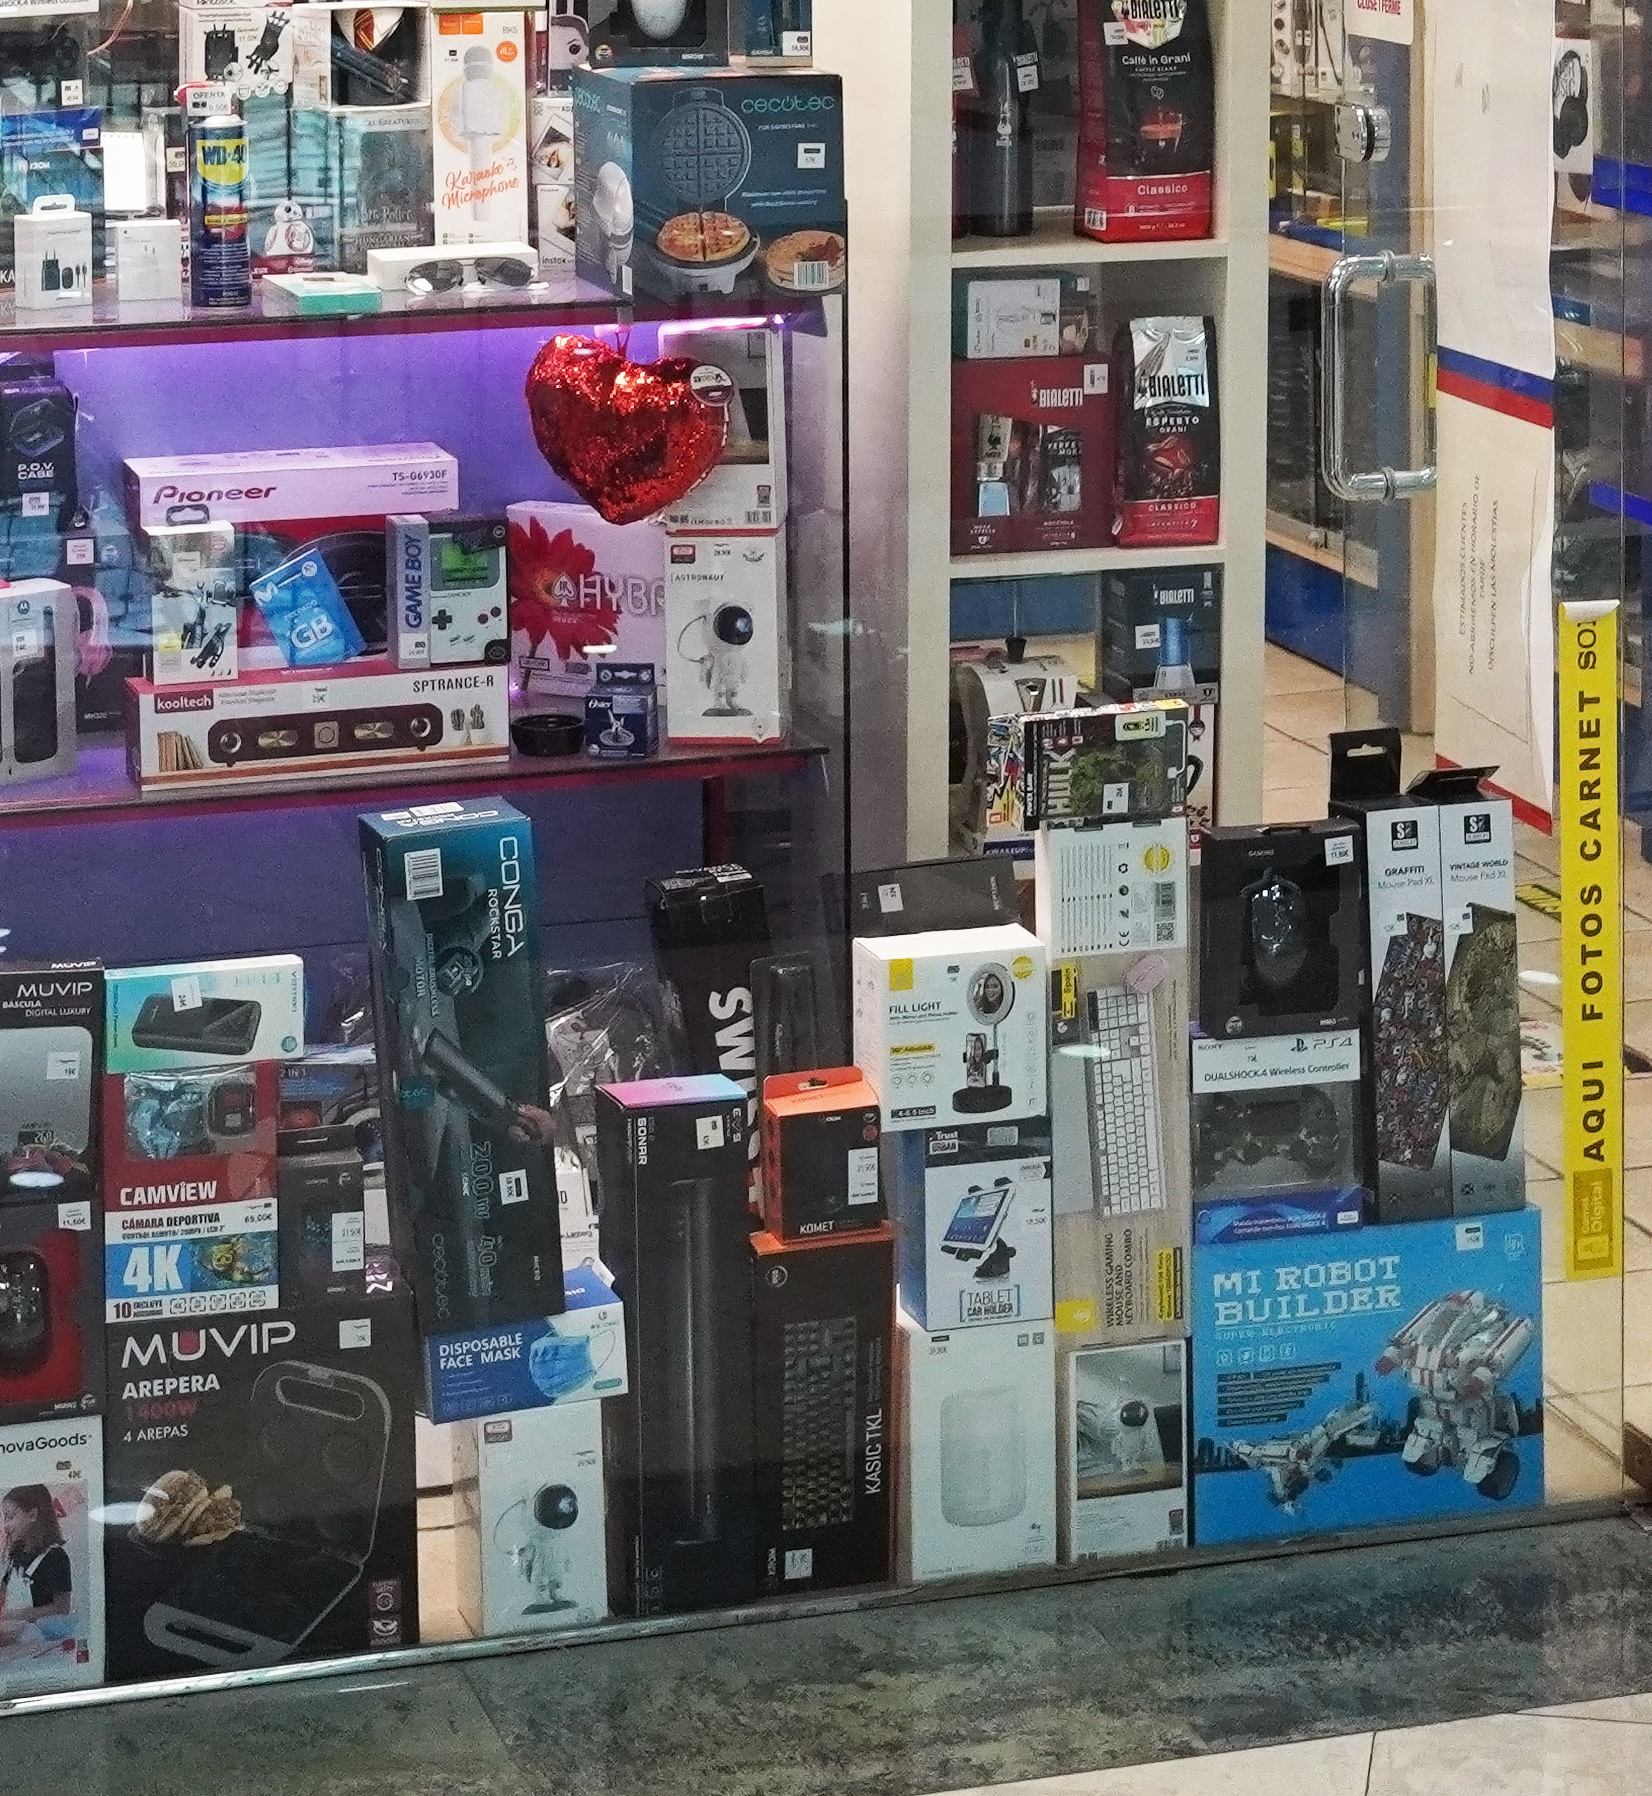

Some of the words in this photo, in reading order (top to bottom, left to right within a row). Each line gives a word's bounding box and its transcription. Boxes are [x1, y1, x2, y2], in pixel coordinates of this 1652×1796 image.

[152, 482, 276, 506] Pioneer
[155, 690, 214, 711] kooltech
[1576, 689, 1604, 862] CARNET
[1578, 883, 1606, 1022] FOTOS
[17, 979, 93, 999] MUVIP
[1578, 1059, 1606, 1163] AQUI
[120, 1179, 216, 1206] CAMVIEW
[124, 1244, 182, 1292] 4K
[1214, 1271, 1264, 1294] MI
[1275, 1256, 1401, 1289] ROBOT
[1214, 1284, 1402, 1323] BUILDER
[121, 1320, 296, 1369] MUVIP
[439, 1333, 522, 1357] DISPOSABLE
[441, 1350, 474, 1370] FACE
[480, 1345, 521, 1366] MASK
[121, 1372, 220, 1399] AREPERA
